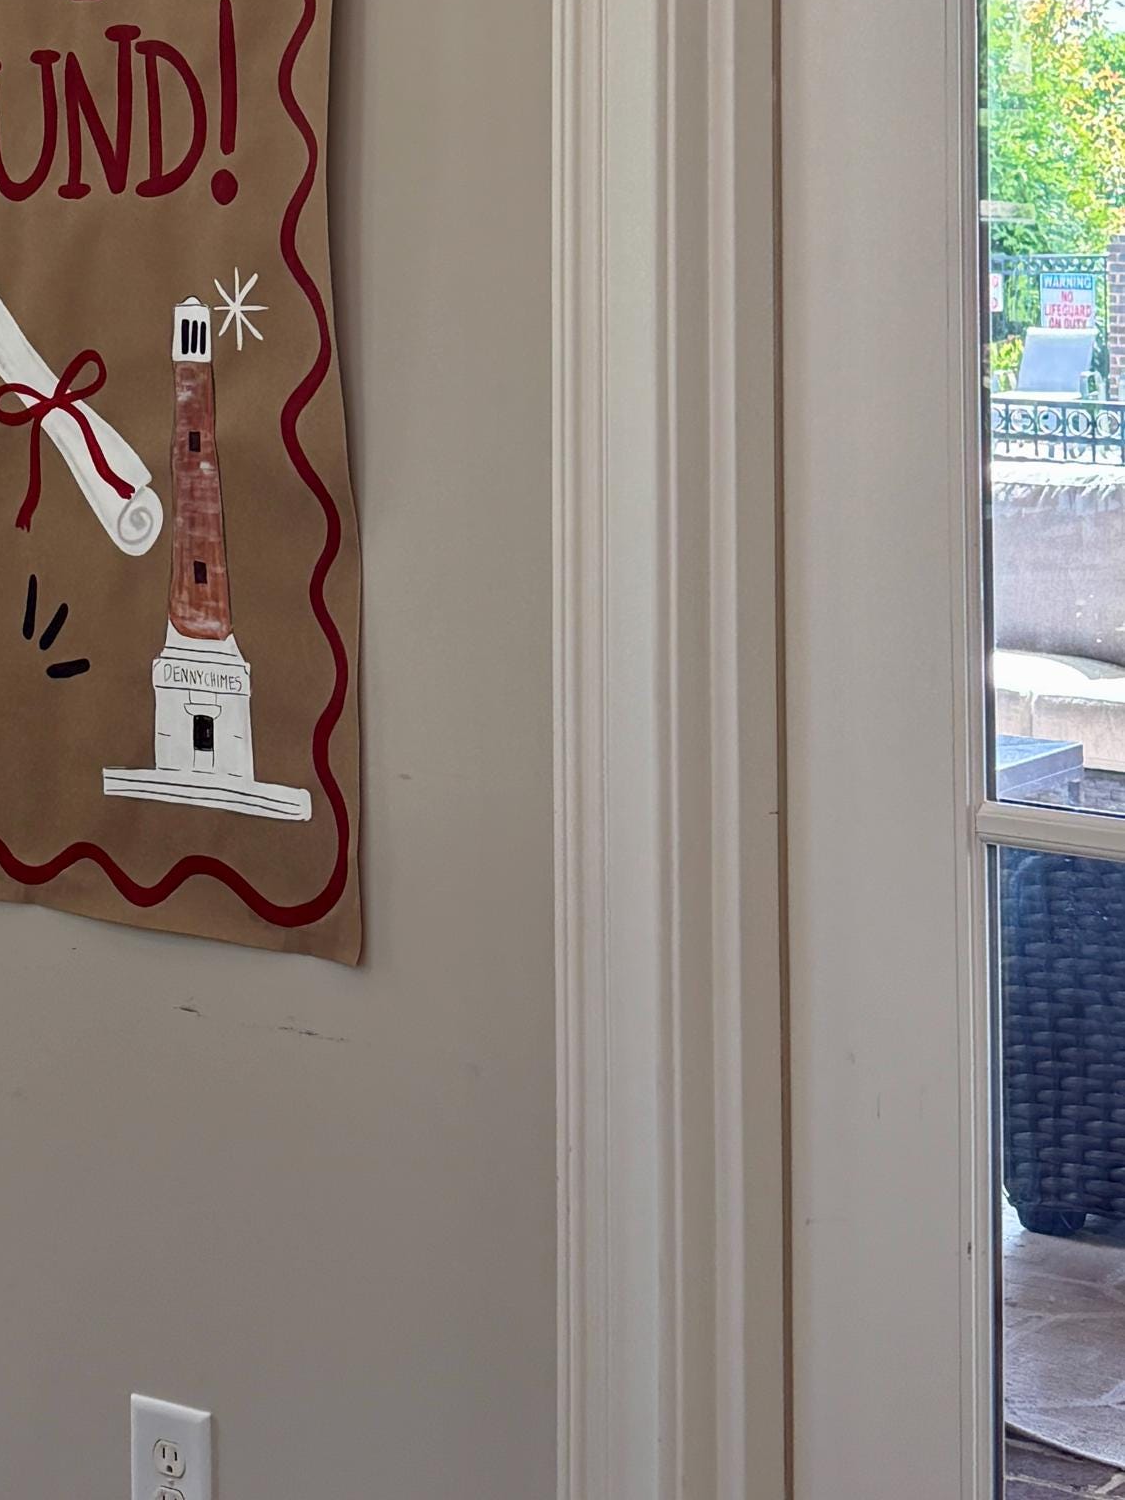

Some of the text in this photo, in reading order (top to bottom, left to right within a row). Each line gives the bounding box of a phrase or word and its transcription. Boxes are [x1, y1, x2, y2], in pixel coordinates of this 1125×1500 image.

[1044, 275, 1092, 289] WARNING
[1061, 291, 1074, 303] NO
[1044, 304, 1092, 317] LIFEGUARD
[1049, 317, 1062, 329] ON
